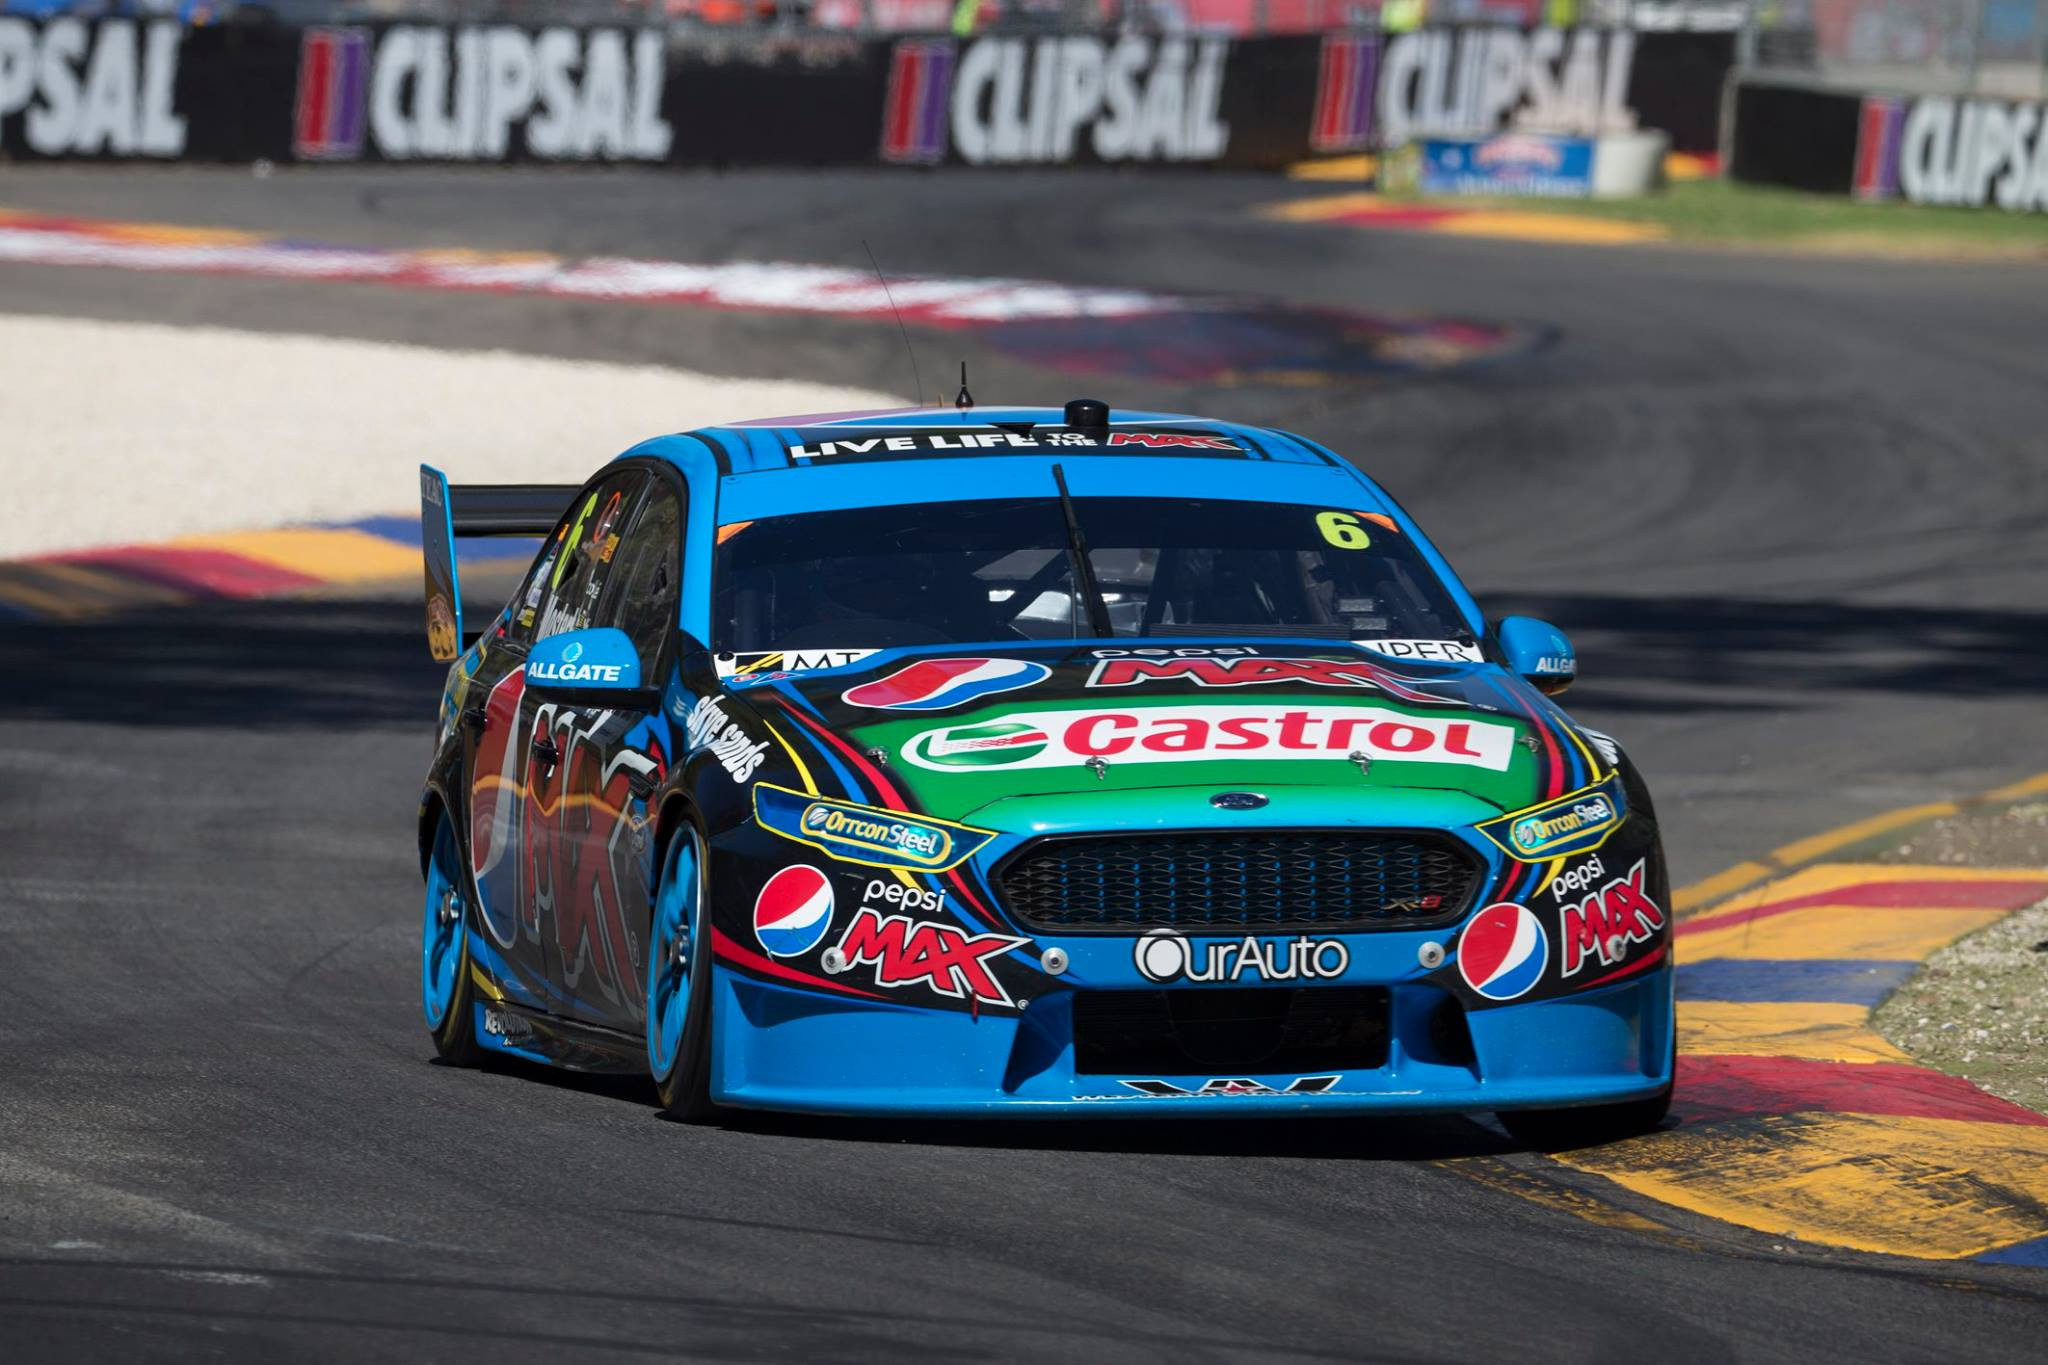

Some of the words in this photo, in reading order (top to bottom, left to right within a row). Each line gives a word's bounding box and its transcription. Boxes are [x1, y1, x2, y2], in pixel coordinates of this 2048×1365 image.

[369, 24, 672, 160] CLIPSAL
[950, 35, 1230, 165] CLIPSAL
[1377, 28, 1640, 138] CLIPSAL
[789, 437, 917, 459] LIVE
[928, 432, 1039, 448] LIFE
[1044, 432, 1086, 440] TO
[1044, 438, 1098, 447] THE
[1106, 432, 1248, 450] MAX
[1315, 511, 1371, 550] 6
[527, 661, 622, 682] ALLGATE
[1085, 657, 1405, 694] MAX
[1063, 711, 1482, 757] Castrol
[862, 880, 947, 912] pepsi
[1551, 853, 1606, 903] pepsi
[1559, 857, 1665, 979] MAX
[835, 906, 1034, 1008] MAX
[1134, 928, 1348, 982] OurAuto
